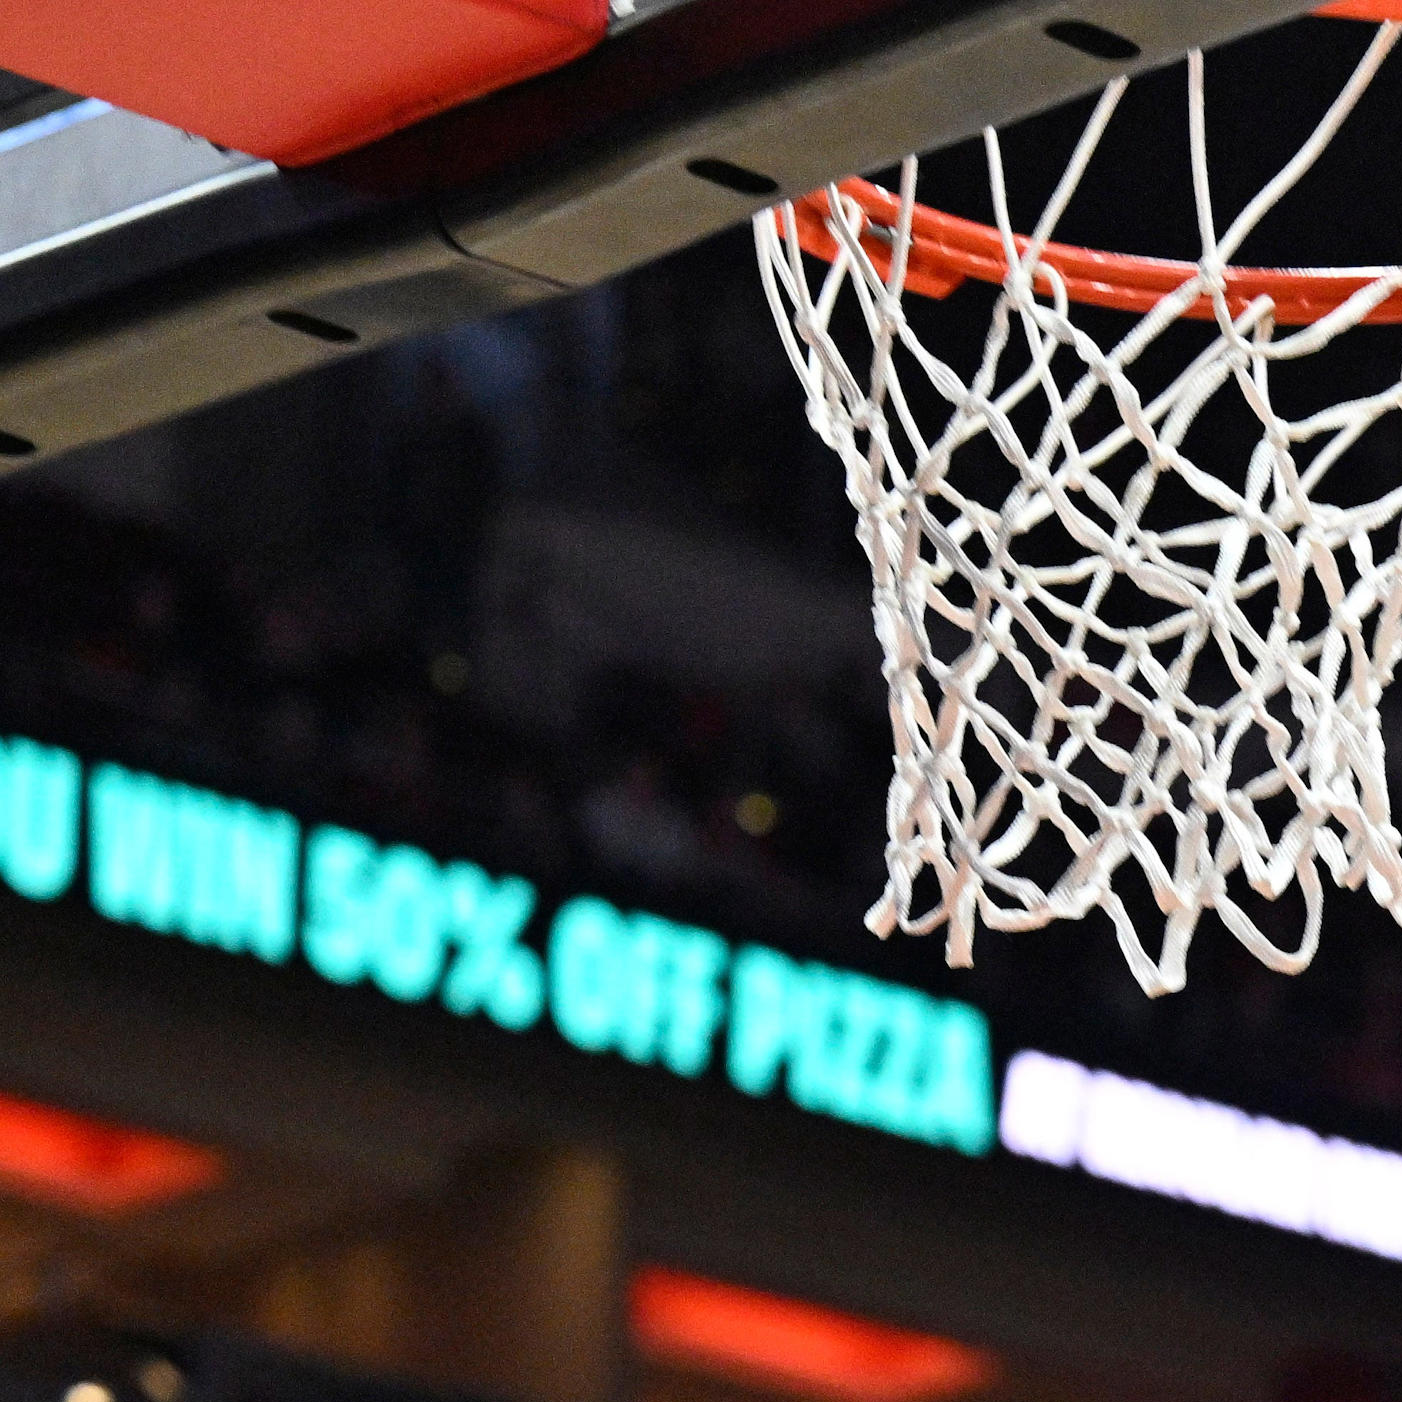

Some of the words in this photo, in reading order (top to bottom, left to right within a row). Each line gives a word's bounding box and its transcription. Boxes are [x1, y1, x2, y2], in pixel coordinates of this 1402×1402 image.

[88, 760, 301, 966] WIN
[301, 824, 546, 1031] 50%
[550, 895, 728, 1078] OFF
[728, 942, 996, 1158] PIZZA
